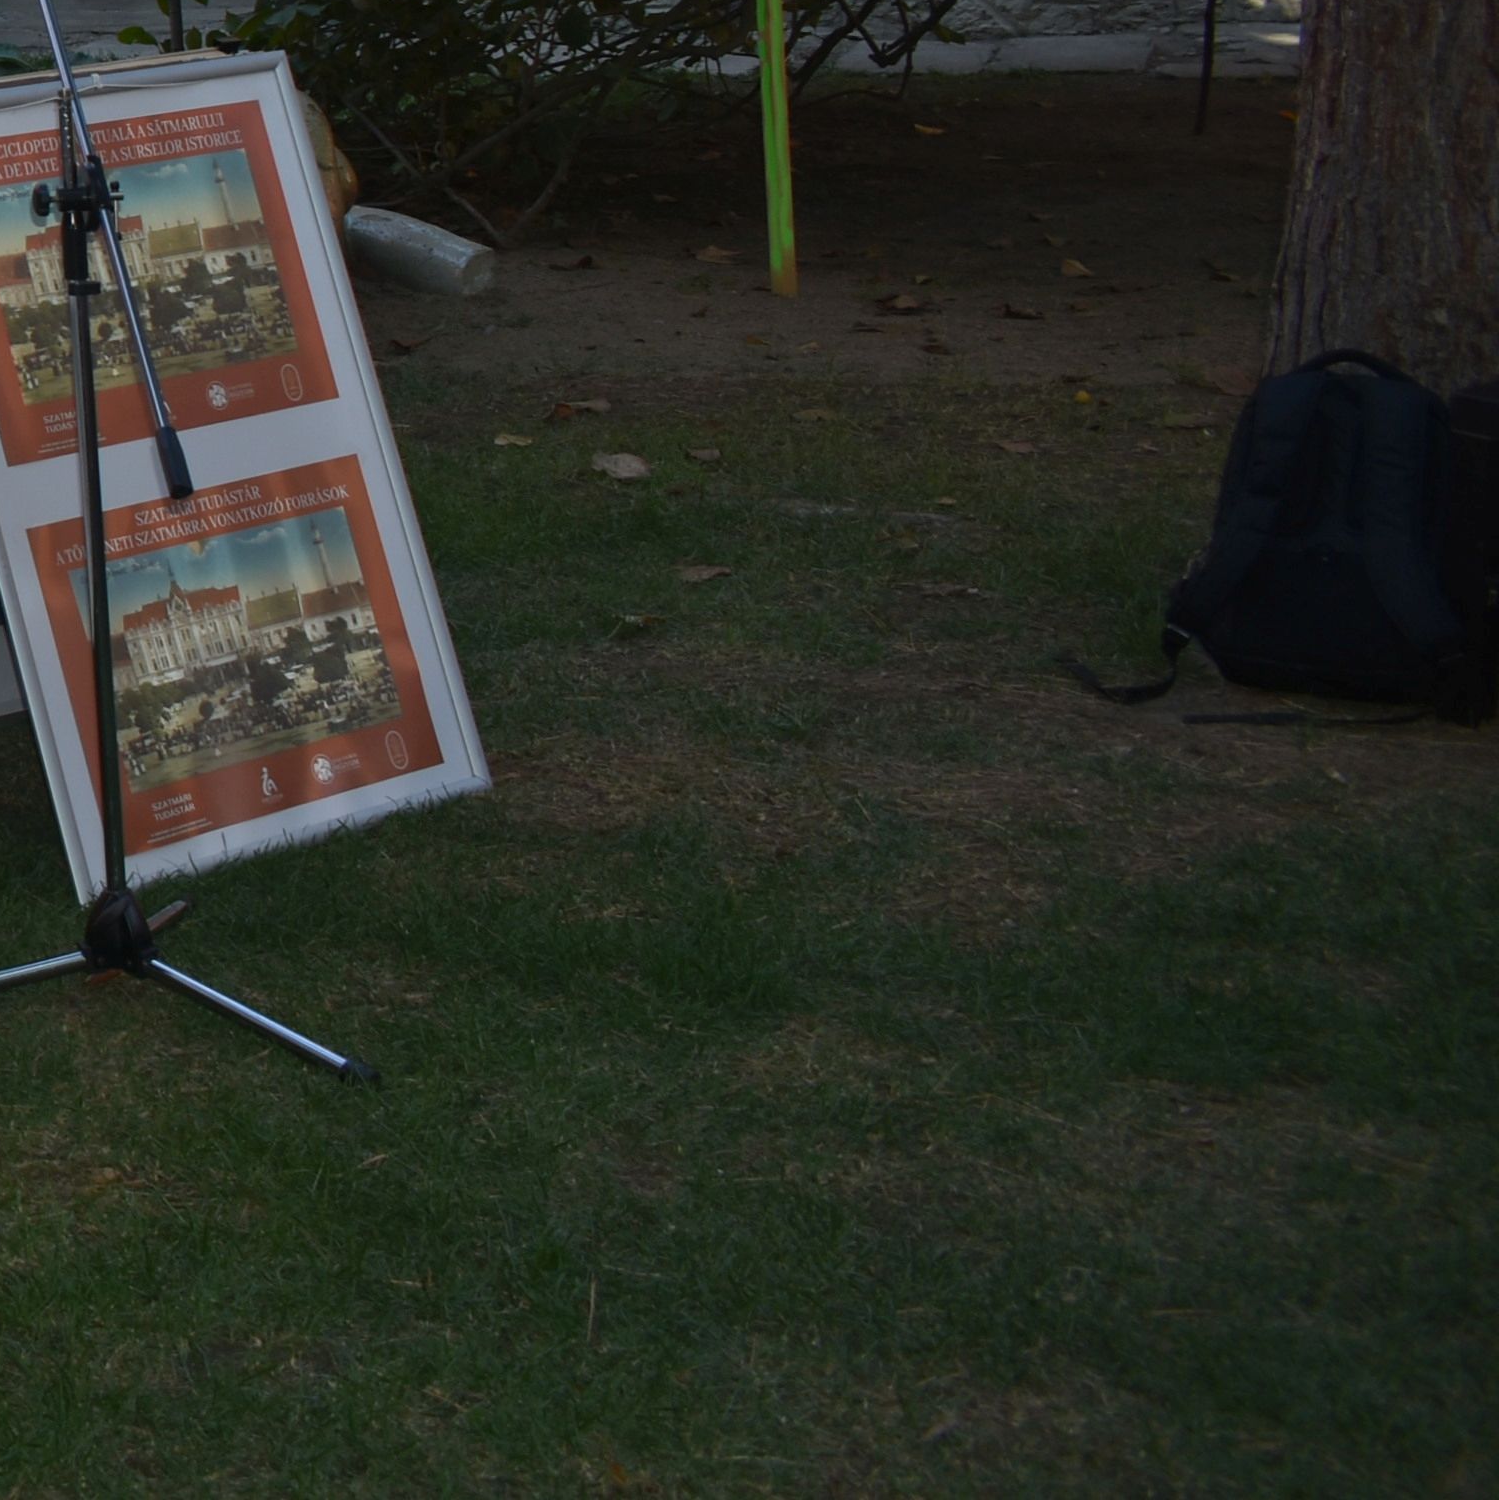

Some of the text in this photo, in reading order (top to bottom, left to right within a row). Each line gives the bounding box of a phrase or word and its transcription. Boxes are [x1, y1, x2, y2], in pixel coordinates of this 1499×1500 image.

[135, 125, 145, 139] A
[147, 112, 225, 135] SĂTMARULUI
[4, 162, 22, 179] DE
[23, 157, 59, 176] DATE
[111, 150, 121, 163] A
[121, 139, 184, 161] SURSELOR
[185, 129, 243, 151] ISTORICE
[56, 551, 66, 566] A
[134, 518, 209, 547] SZATMÁRRA
[209, 496, 284, 529] VONATKOZÓ
[284, 484, 349, 512] FORRÁSOK
[134, 483, 261, 526] SZATMÁRI TUDÁSTÁR
